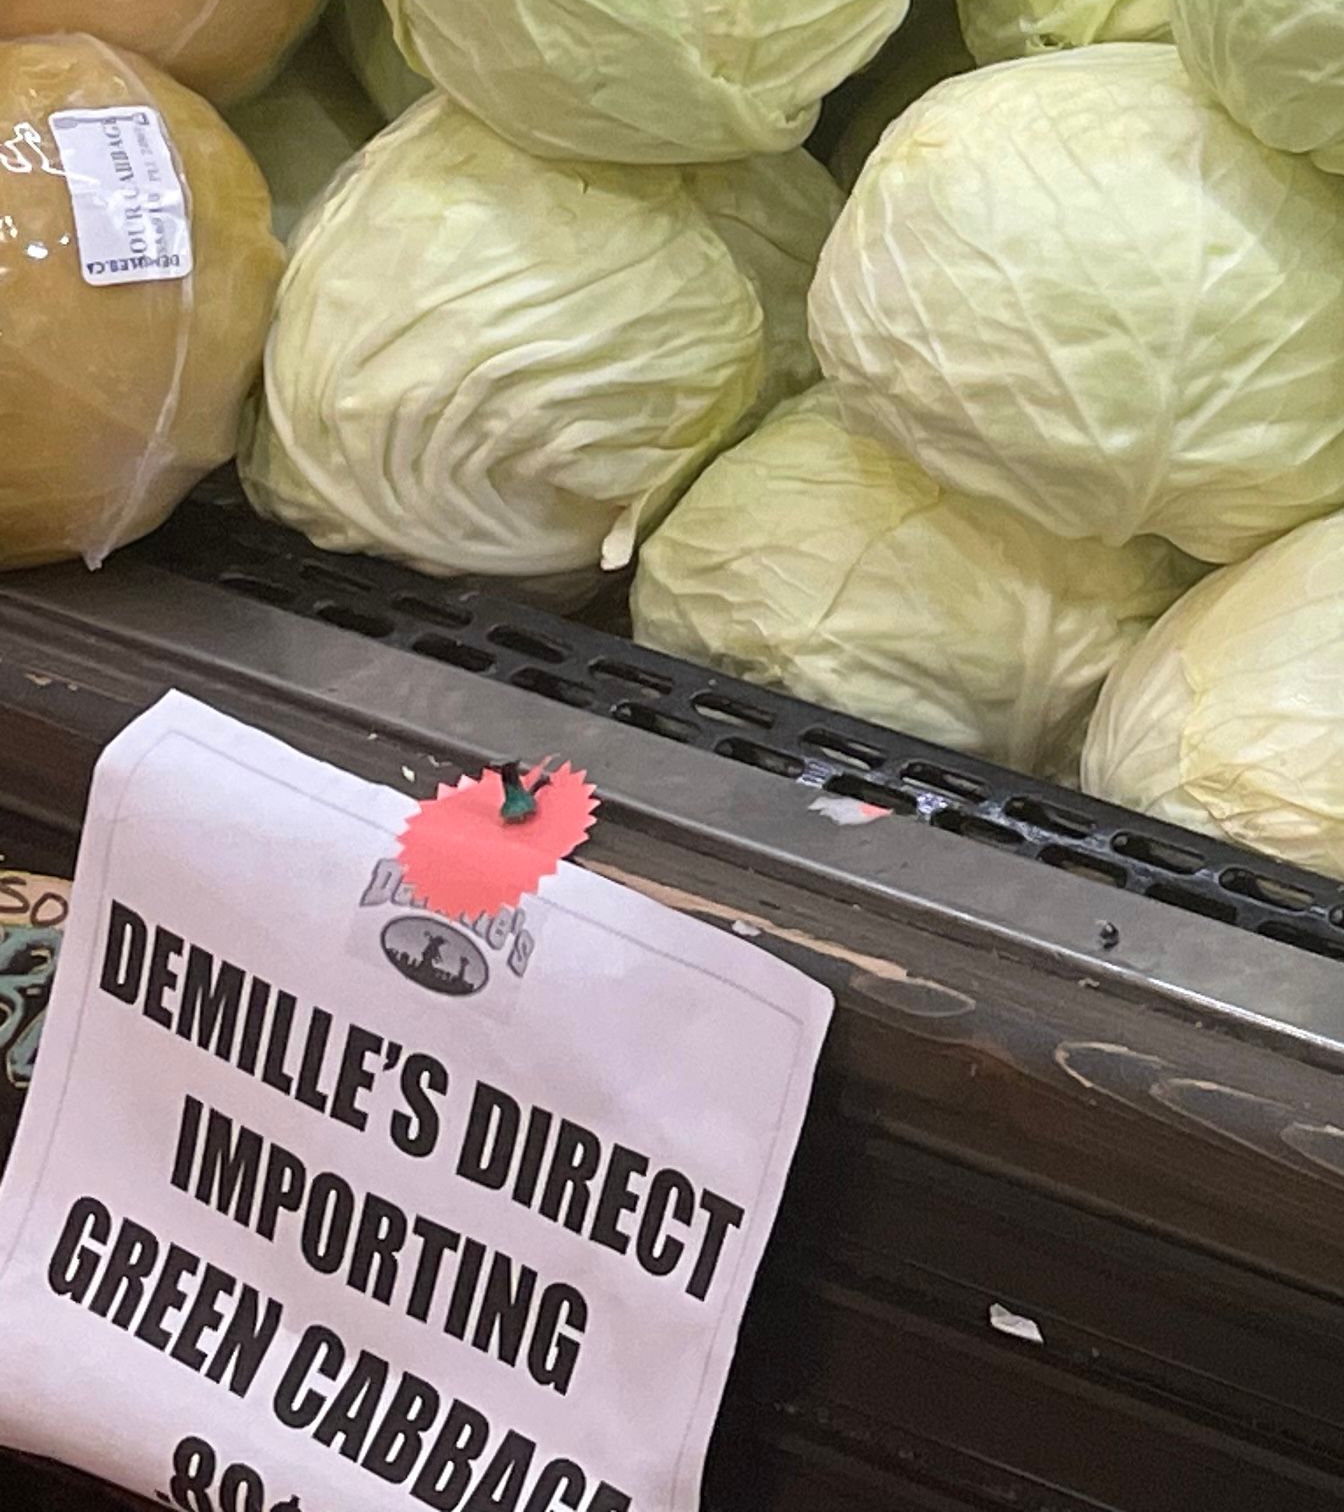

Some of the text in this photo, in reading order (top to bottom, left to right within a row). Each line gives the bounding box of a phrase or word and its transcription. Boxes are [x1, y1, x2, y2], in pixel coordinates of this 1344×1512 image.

[100, 899, 450, 1159] DEMILLE'S
[456, 1079, 745, 1303] DIRECT
[170, 1093, 588, 1396] IMPORTING
[47, 1195, 284, 1399] GREEN
